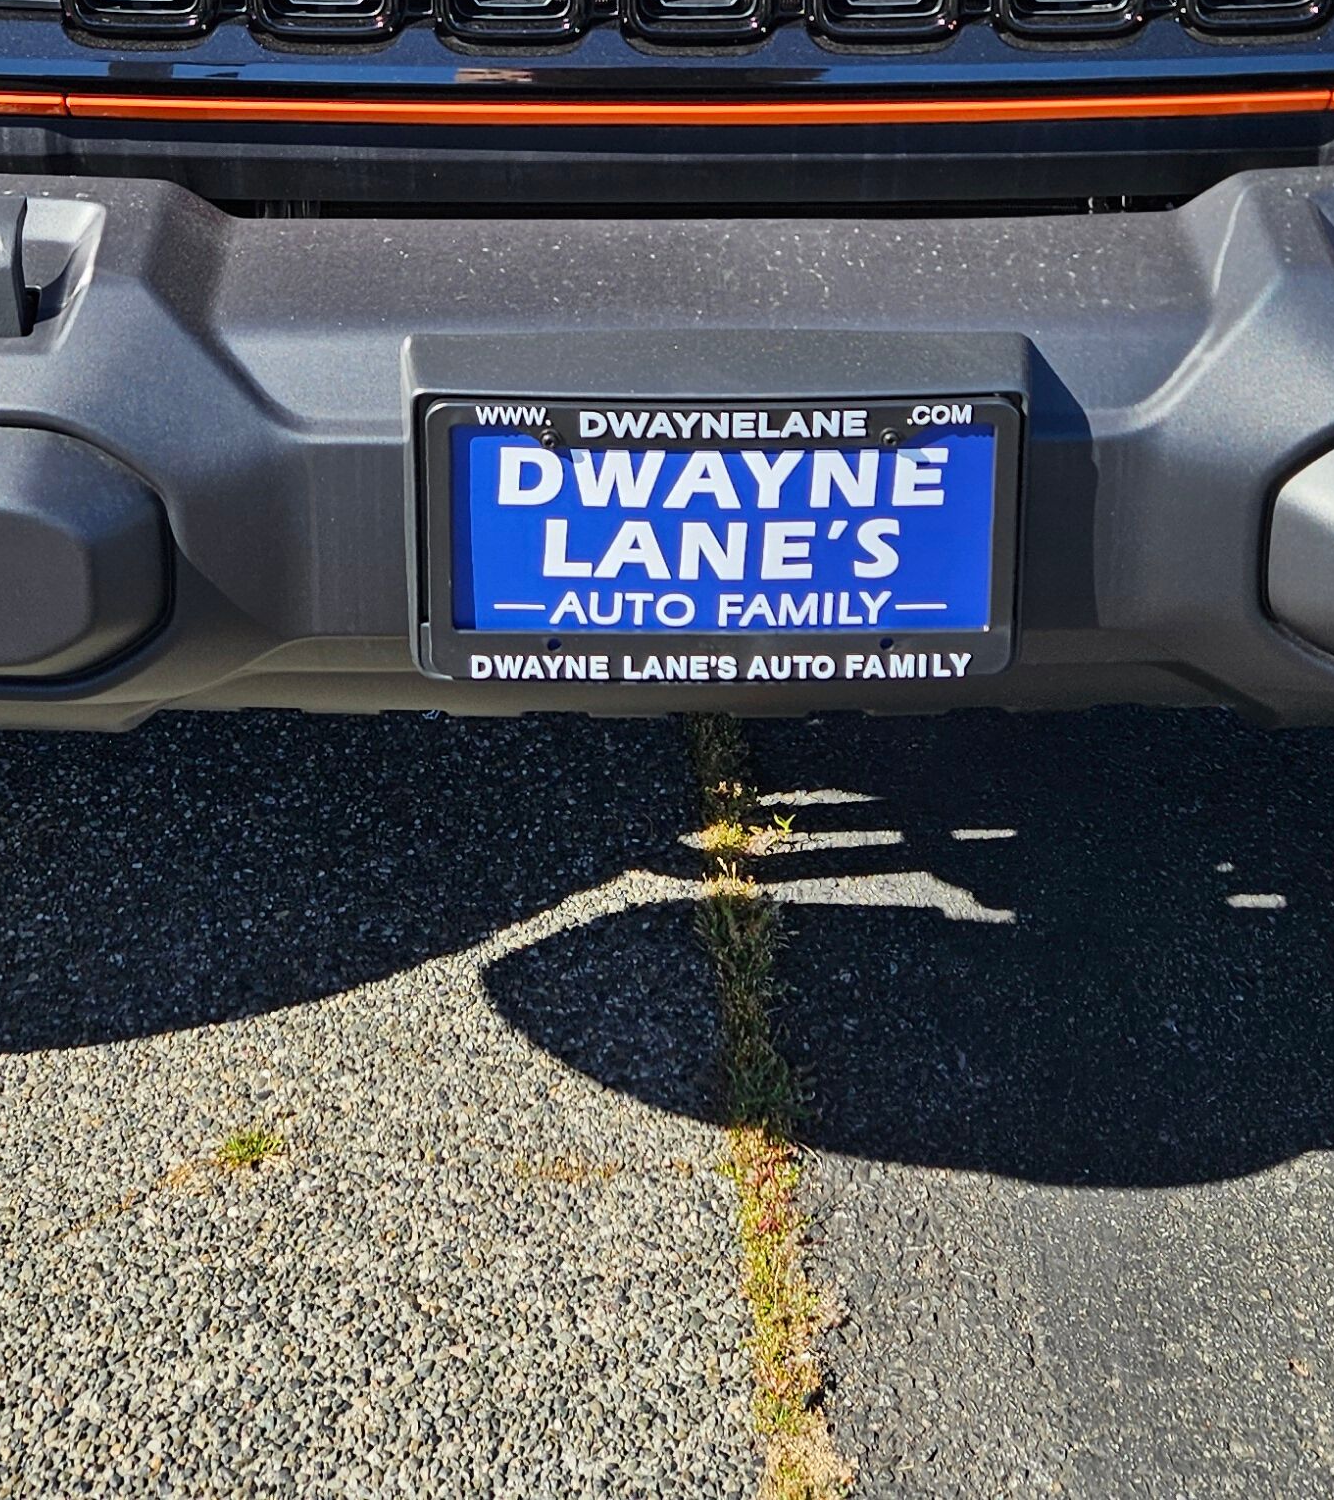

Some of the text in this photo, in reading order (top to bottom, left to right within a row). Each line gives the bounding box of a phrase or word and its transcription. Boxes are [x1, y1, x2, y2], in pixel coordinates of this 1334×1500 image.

[475, 404, 972, 439] WWW. DWAYNELANE .COM
[498, 446, 949, 509] DWAYNE
[543, 518, 901, 581] LANE'S
[548, 590, 893, 627] AUTO FAMILY
[471, 652, 972, 680] DWAYNE LANE'S AUTO FAMILY
